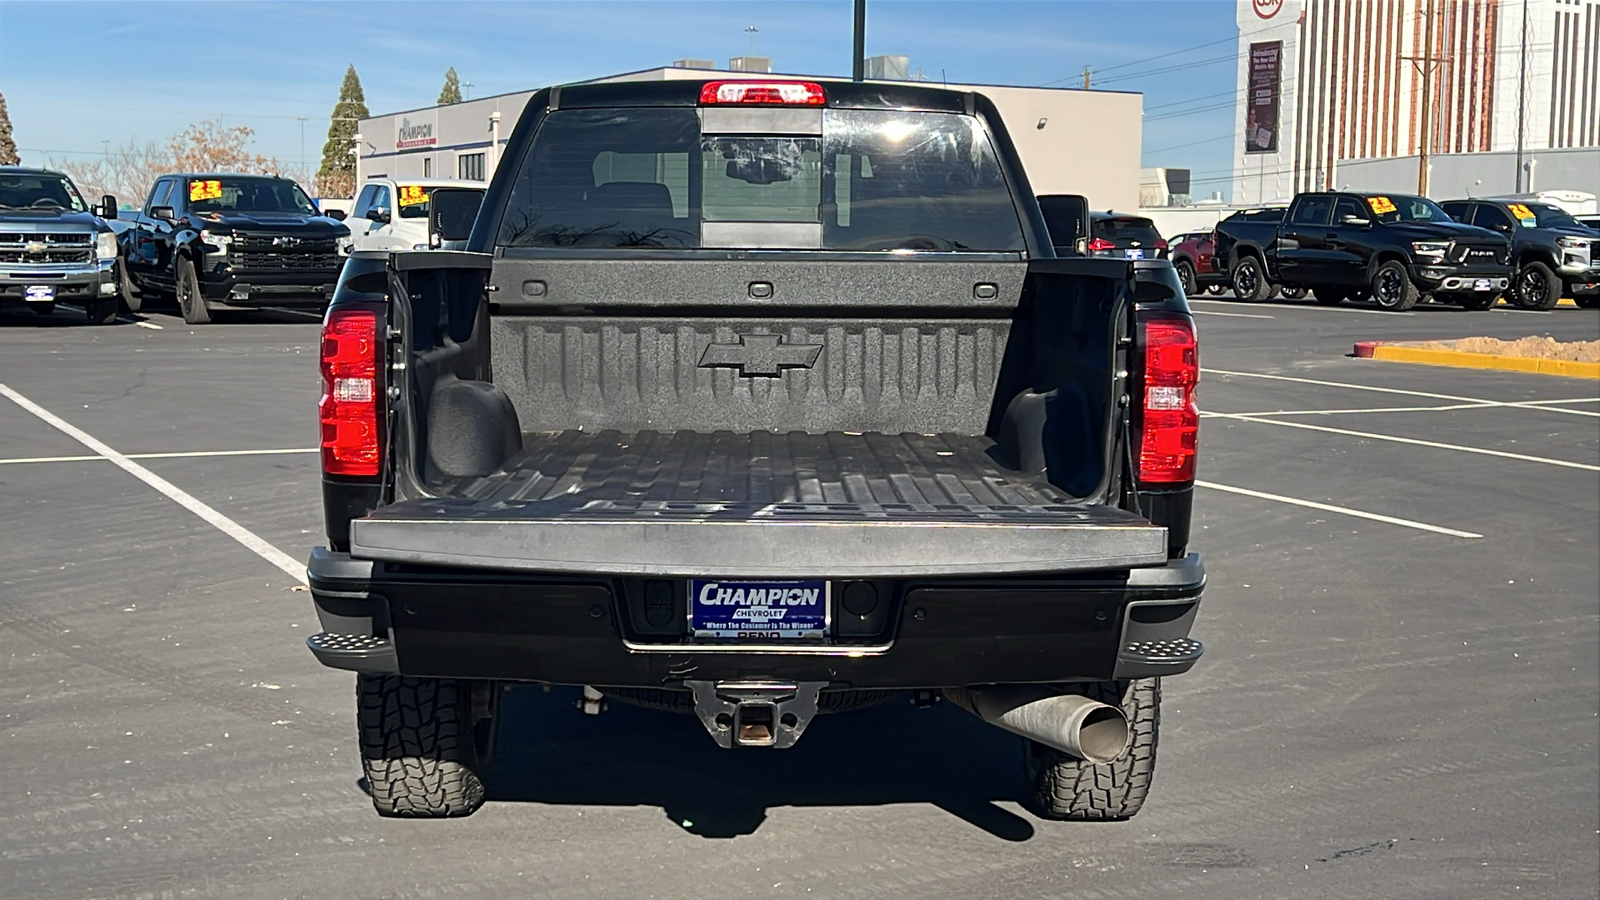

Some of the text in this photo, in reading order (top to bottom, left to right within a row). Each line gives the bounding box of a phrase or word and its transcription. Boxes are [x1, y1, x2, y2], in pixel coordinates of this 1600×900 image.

[401, 186, 421, 199] 18
[699, 583, 820, 606] CHAMPION
[735, 610, 783, 618] CHEVROLET
